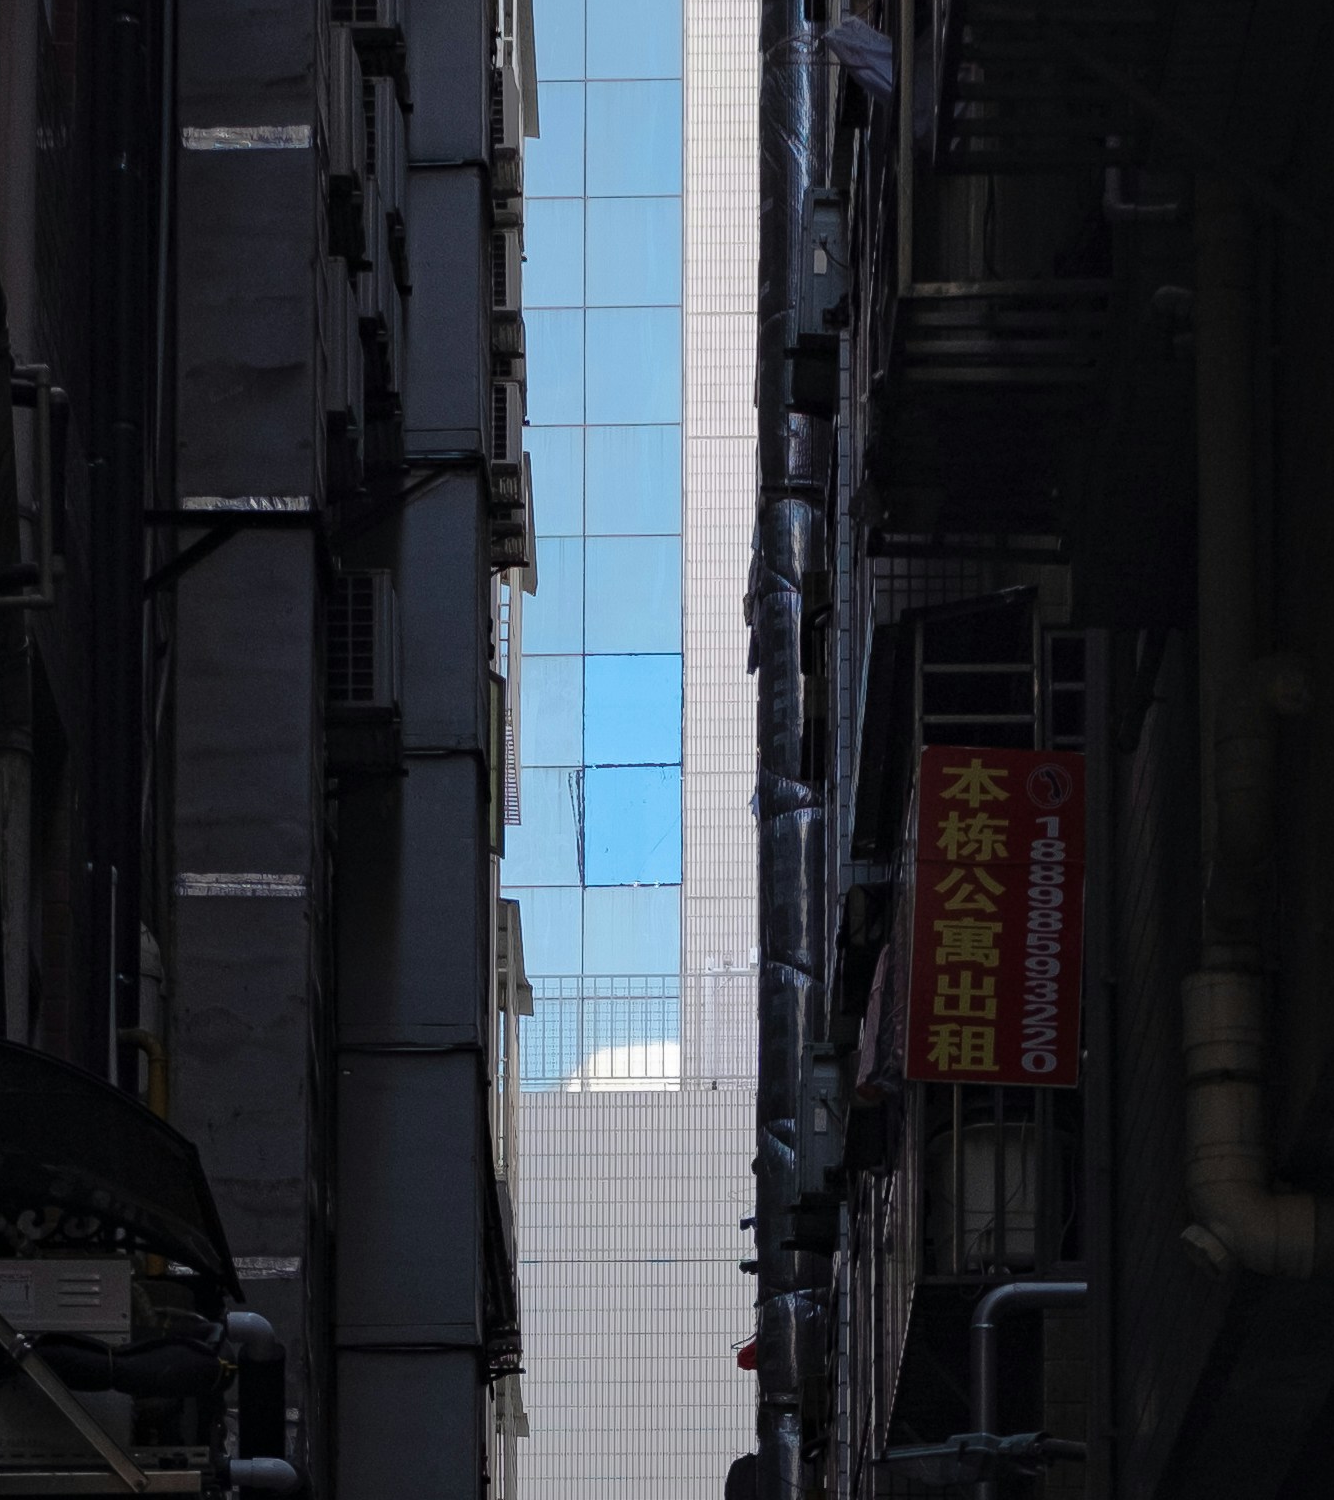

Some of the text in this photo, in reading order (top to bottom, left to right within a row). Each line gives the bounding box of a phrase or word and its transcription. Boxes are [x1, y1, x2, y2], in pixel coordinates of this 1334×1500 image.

[927, 758, 1011, 1072] 本栋公寓出租
[1021, 816, 1066, 1073] 18898593220
